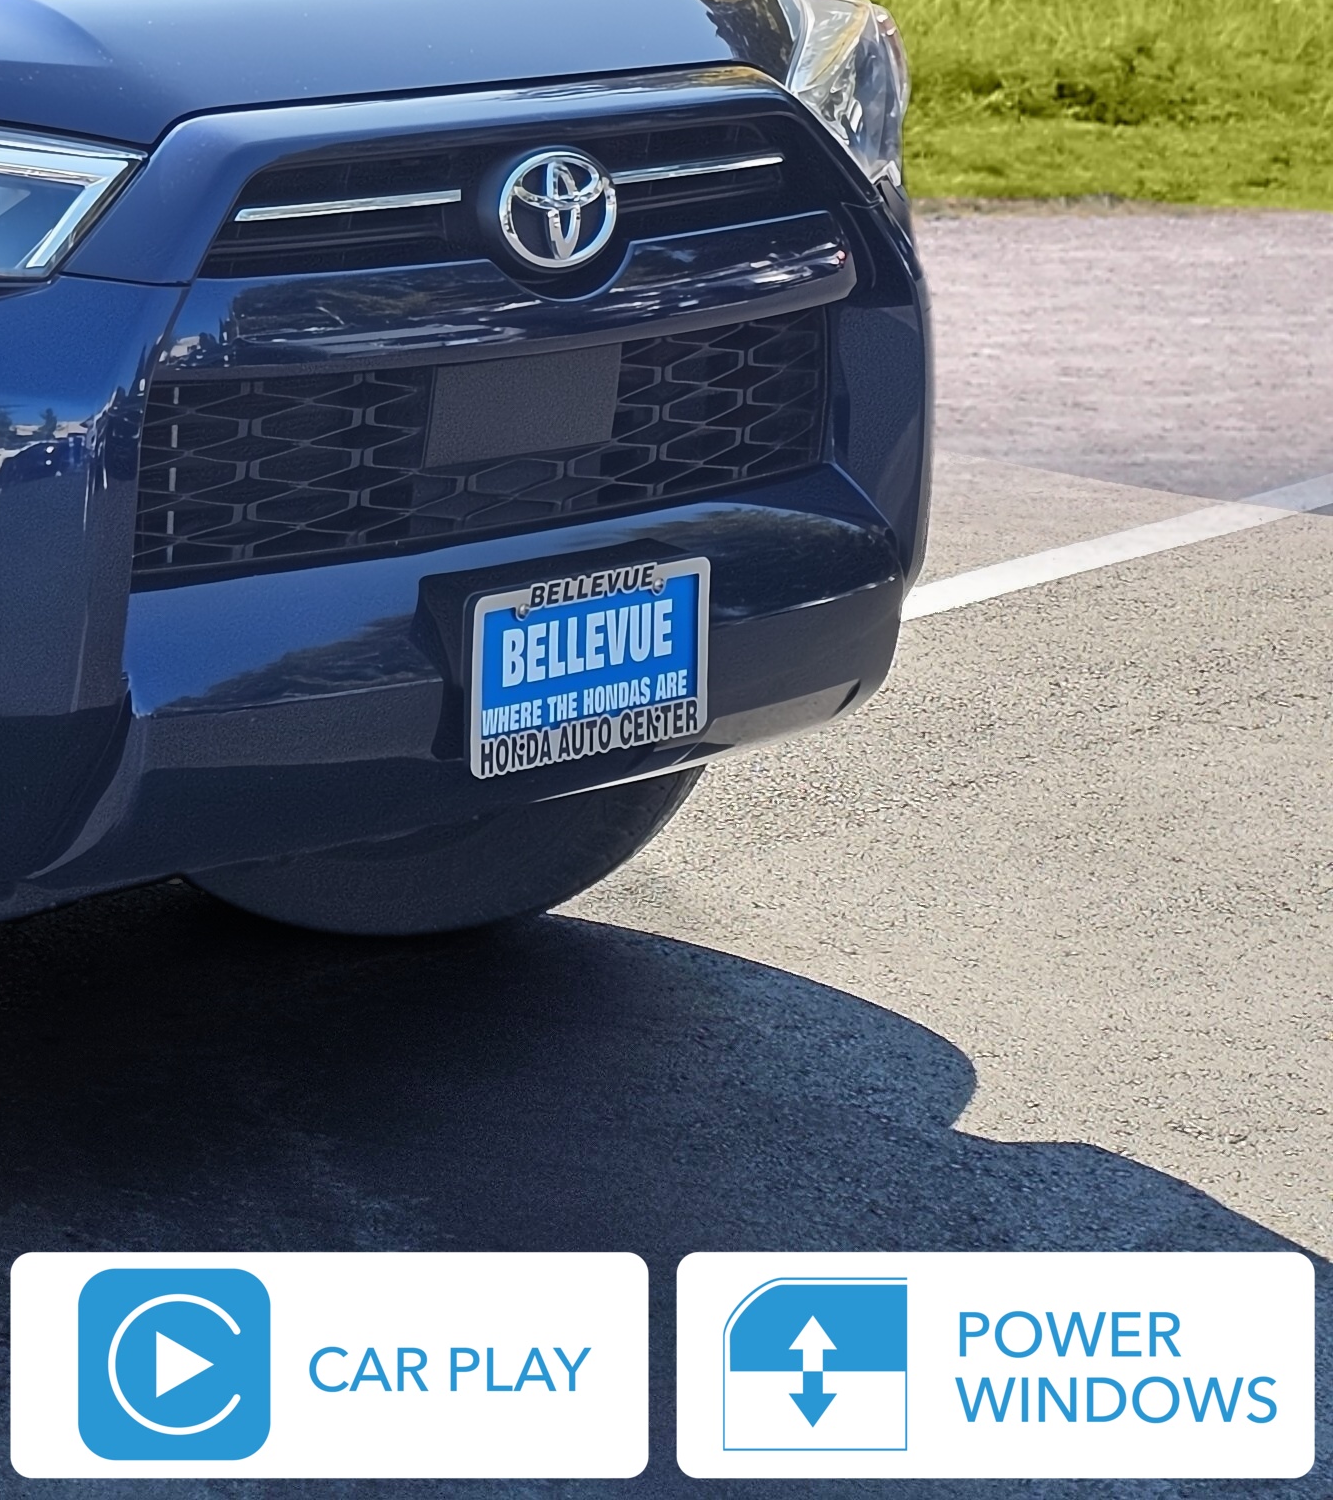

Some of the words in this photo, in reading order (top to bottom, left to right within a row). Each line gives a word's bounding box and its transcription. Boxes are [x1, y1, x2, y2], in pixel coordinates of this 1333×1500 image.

[531, 564, 655, 608] BELLEVUE
[501, 598, 673, 688] BELLEVUE
[481, 731, 552, 777] HONDA
[559, 716, 613, 759] AUTO
[619, 699, 699, 747] CENTER
[482, 699, 542, 736] WHERE
[547, 692, 578, 721] THE
[582, 678, 651, 715] HONDAS
[654, 669, 688, 701] ARE
